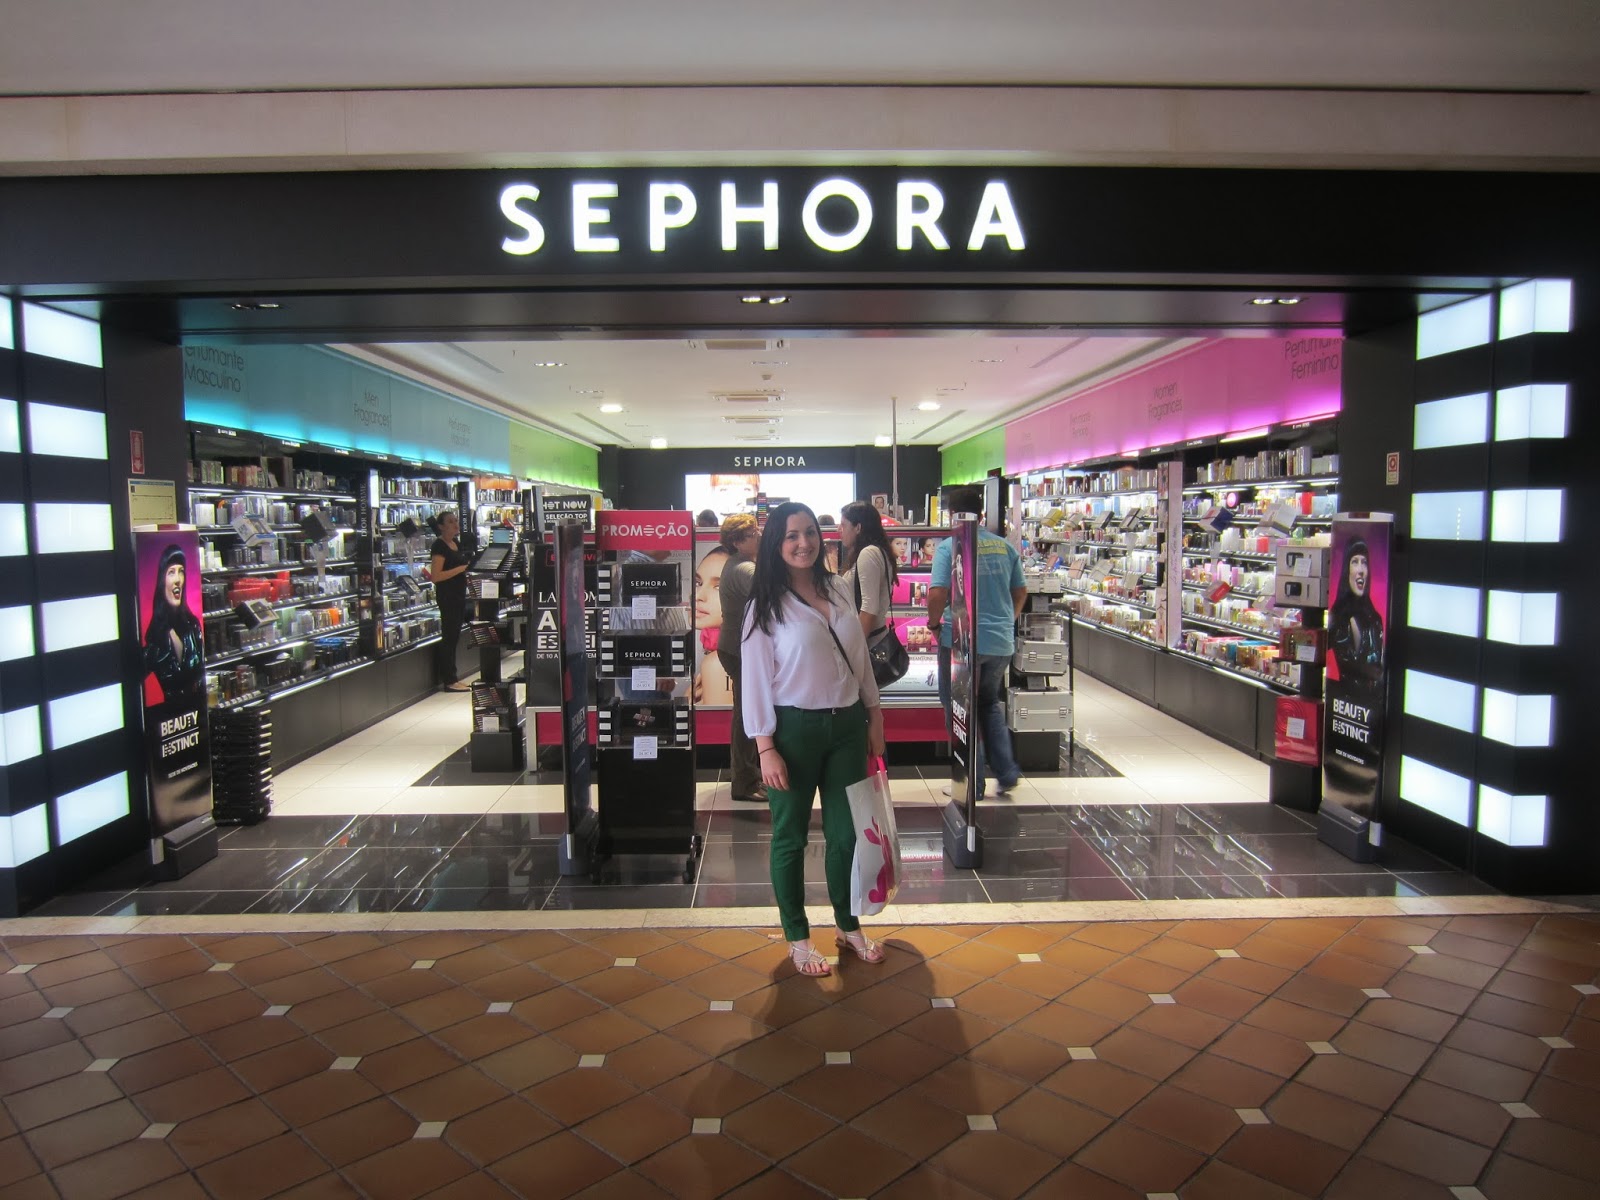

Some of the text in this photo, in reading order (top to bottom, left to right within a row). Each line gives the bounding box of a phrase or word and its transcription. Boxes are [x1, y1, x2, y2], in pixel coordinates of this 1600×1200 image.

[499, 178, 1026, 256] SEPHORA
[184, 361, 241, 392] Masculino
[1291, 354, 1339, 381] Feminino
[734, 455, 807, 467] SEPHORA
[563, 501, 587, 509] NOW
[602, 522, 689, 539] PROMOÇÃO
[161, 710, 199, 737] BEAUTY
[1333, 698, 1370, 723] BEAUTY
[162, 731, 200, 758] INSTINCT
[1332, 719, 1369, 744] INSTINCT
